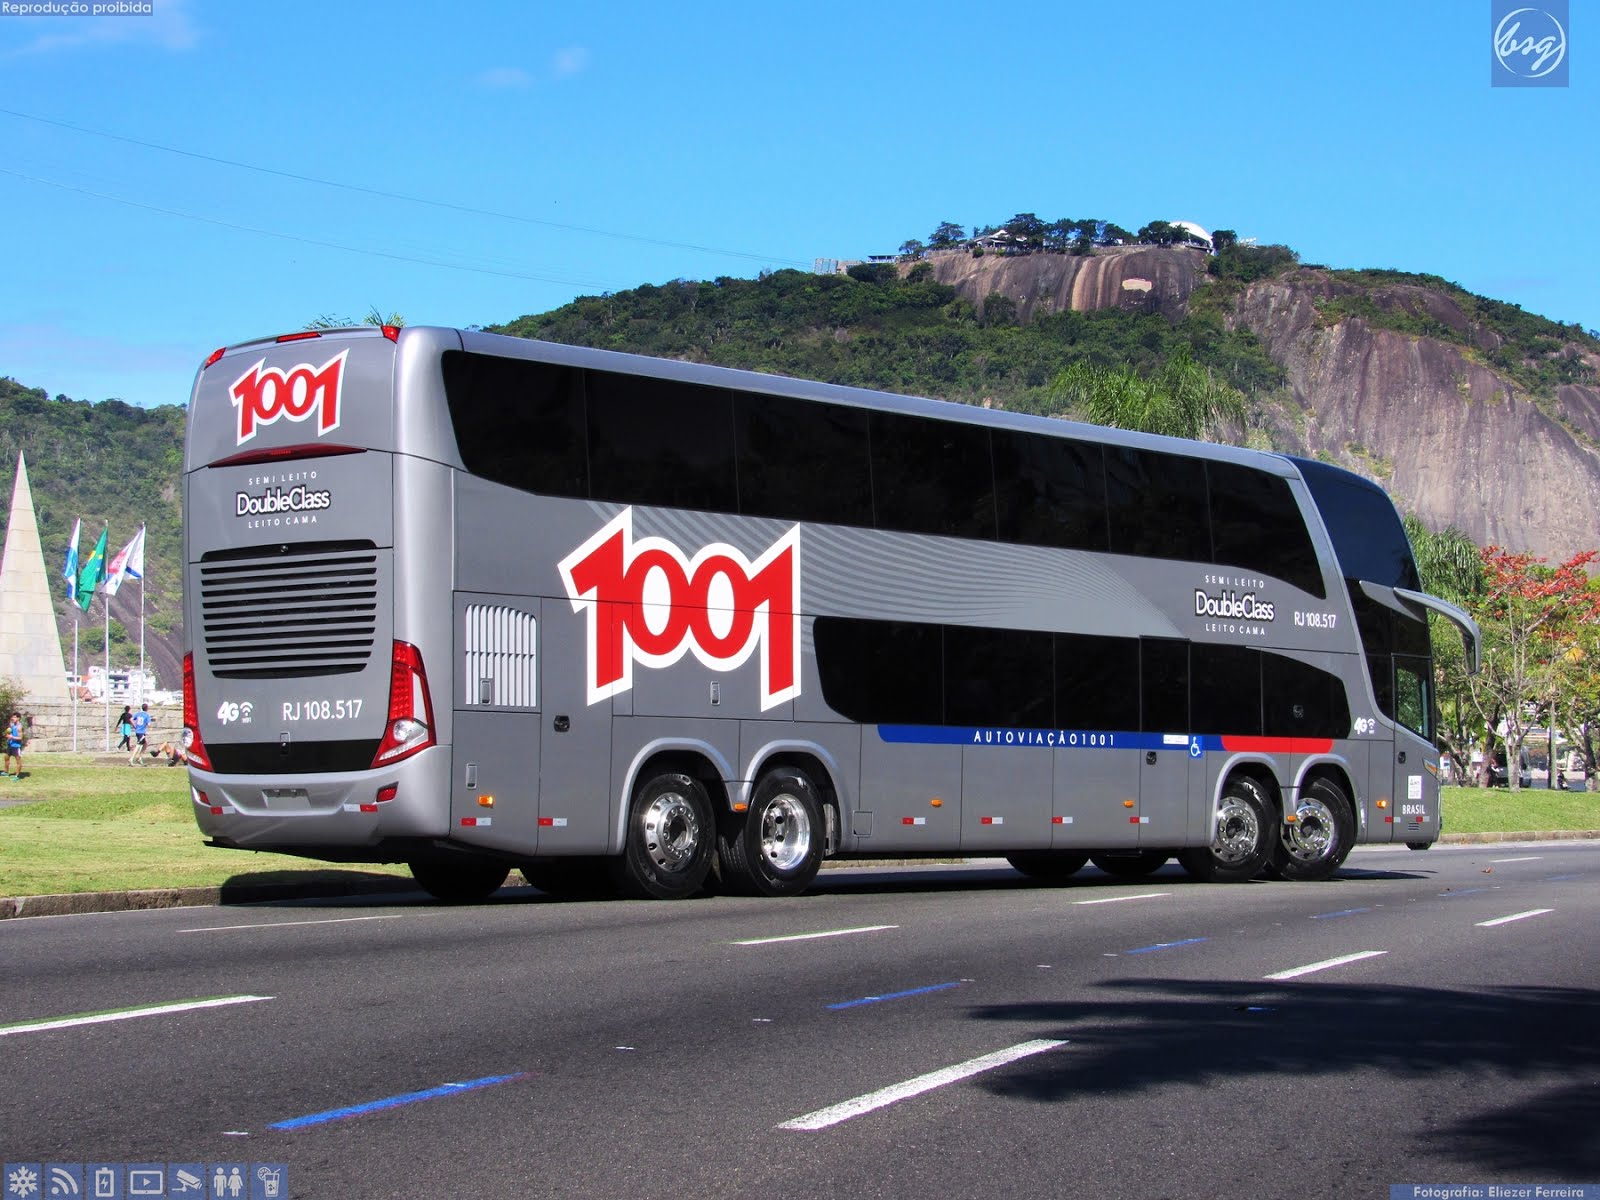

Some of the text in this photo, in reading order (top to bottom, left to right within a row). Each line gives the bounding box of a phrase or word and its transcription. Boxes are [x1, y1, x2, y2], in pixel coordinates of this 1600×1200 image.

[228, 348, 350, 446] 1001
[248, 471, 317, 486] SEMI LEITO
[236, 485, 331, 516] DoubleClass
[248, 515, 317, 529] LEITO CAMA
[1205, 574, 1265, 589] SEMI LEITO
[557, 505, 801, 712] 1001
[1195, 590, 1275, 621] DoubleClass
[1205, 623, 1266, 636] LEITO CAMA
[1294, 611, 1337, 629] RJ 108.517
[217, 701, 240, 726] 4G
[283, 699, 363, 721] RJ 108.517
[1354, 716, 1368, 735] 4G
[1402, 804, 1426, 815] BRASIL
